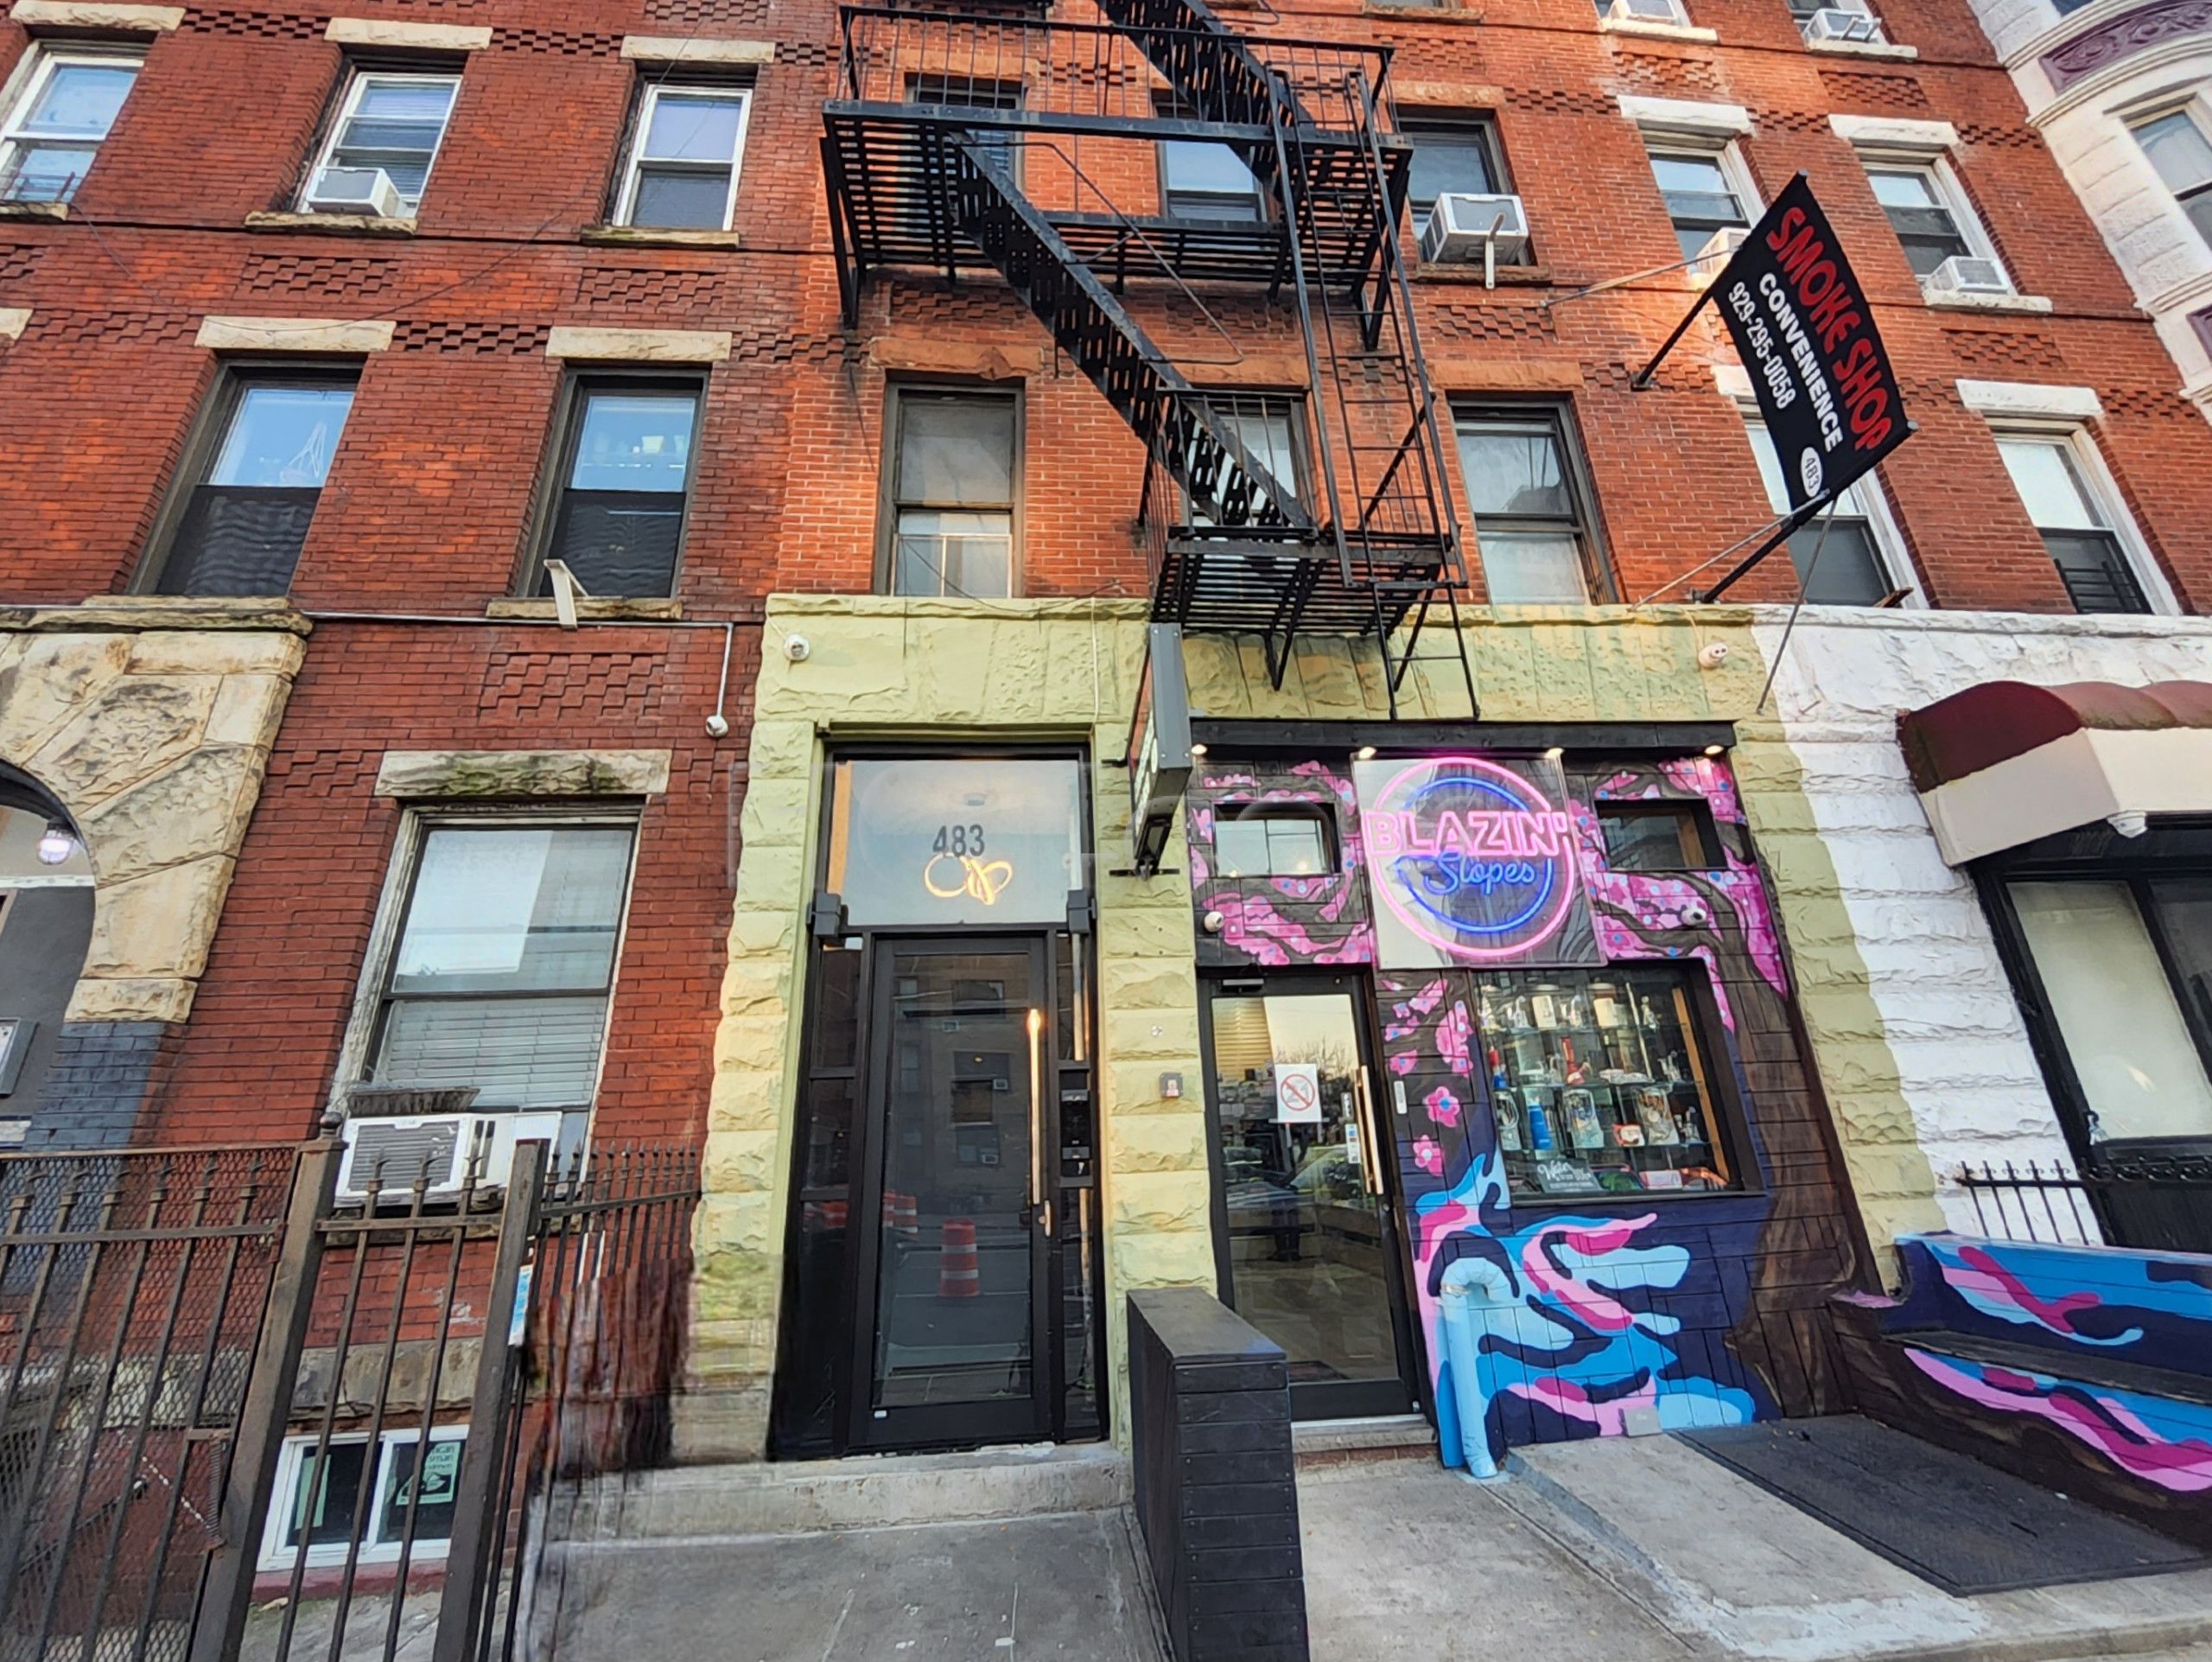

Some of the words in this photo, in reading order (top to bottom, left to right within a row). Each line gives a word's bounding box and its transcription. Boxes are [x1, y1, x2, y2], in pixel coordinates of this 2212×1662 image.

[1728, 281, 1796, 411] 929-295-0058
[1759, 273, 1844, 453] CONVENIENCE
[1766, 207, 1861, 354] SMOKE
[1832, 338, 1892, 451] SHOP
[932, 824, 985, 858] 483
[1363, 810, 1568, 856] BLAZIN'
[1422, 851, 1535, 895] Slopes
